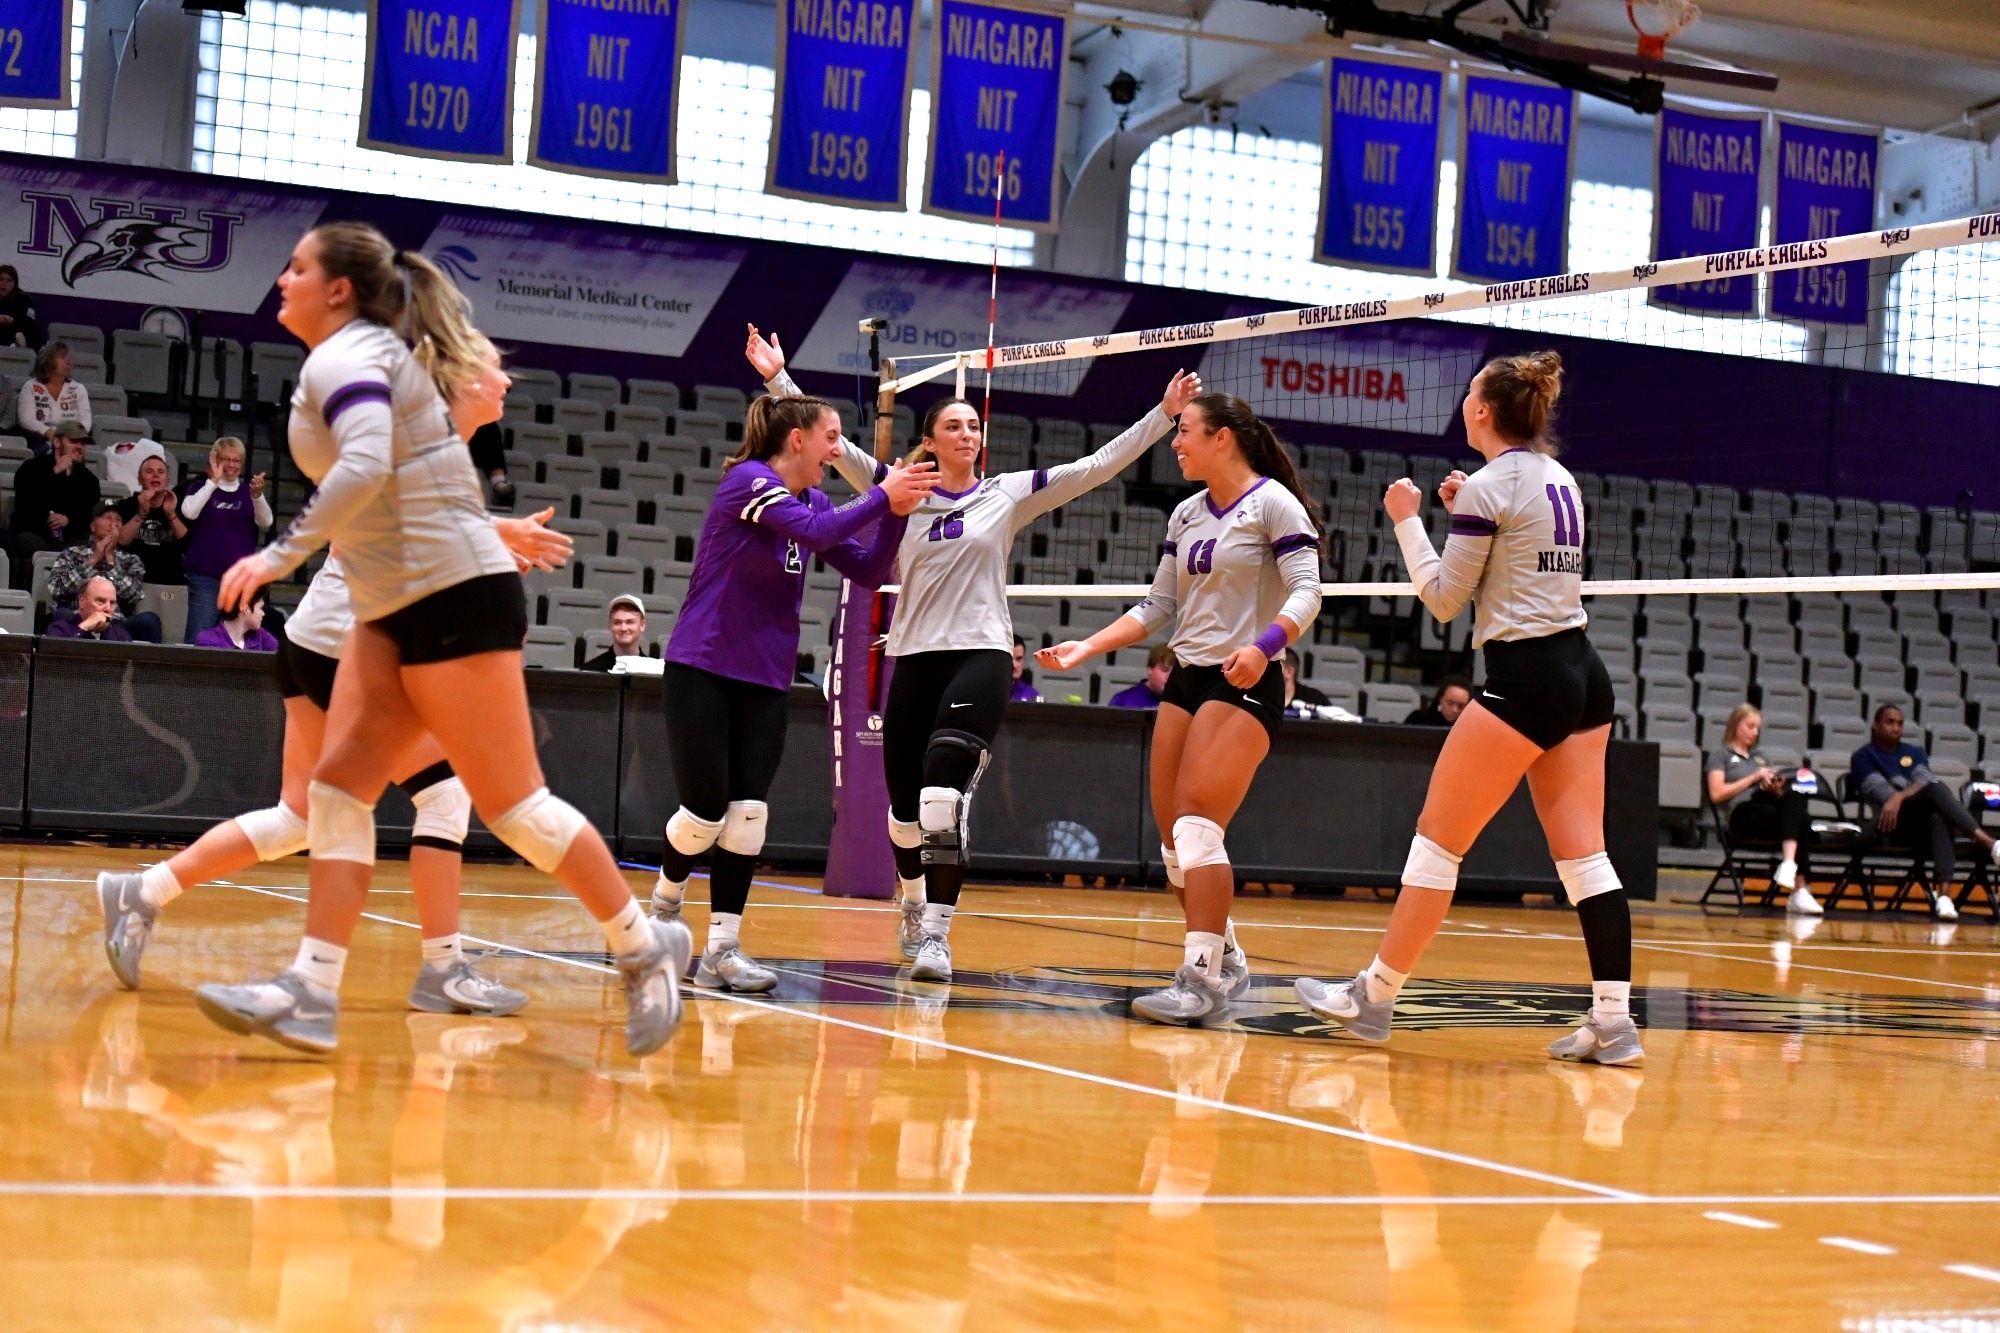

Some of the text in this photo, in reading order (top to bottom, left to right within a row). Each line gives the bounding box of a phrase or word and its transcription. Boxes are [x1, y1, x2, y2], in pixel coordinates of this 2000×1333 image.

[404, 9, 478, 63] NCAA
[793, 0, 904, 48] NIAGARA
[947, 13, 1054, 71] NIAGARA
[586, 34, 631, 82] NIT
[405, 81, 470, 133] 1970
[823, 65, 866, 112] NIT
[976, 86, 1018, 133] NIT
[1335, 71, 1434, 125] NIAGARA
[574, 102, 632, 152] 1961
[1468, 90, 1564, 145] NIAGARA
[808, 131, 868, 182] 1958
[1363, 141, 1400, 185] NIT
[1666, 126, 1755, 175] NIAGARA
[1784, 141, 1872, 190] NIAGARA
[1496, 159, 1532, 205] NIT
[1353, 202, 1405, 250] 1955
[1691, 191, 1724, 234] NIT
[1808, 204, 1841, 240] NIT
[1486, 221, 1536, 269] 1954
[1705, 249, 1764, 274] PURPLE
[1768, 241, 1828, 265] EAGLES
[498, 278, 692, 313] Memorial Medical Center
[1485, 272, 1589, 302] PURPLE EAGLES
[1794, 267, 1847, 309] 1950
[1139, 322, 1215, 345] PURPLE EAGLES
[1298, 300, 1387, 326] PURPLE EAGLES
[1002, 341, 1066, 362] PURPLE EAGLES
[1261, 356, 1406, 404] TOSHIBA
[928, 510, 965, 541] 16
[1546, 484, 1580, 547] 11
[784, 538, 802, 574] 2
[1187, 538, 1217, 575] 13
[1537, 551, 1582, 574] NIAGAR
